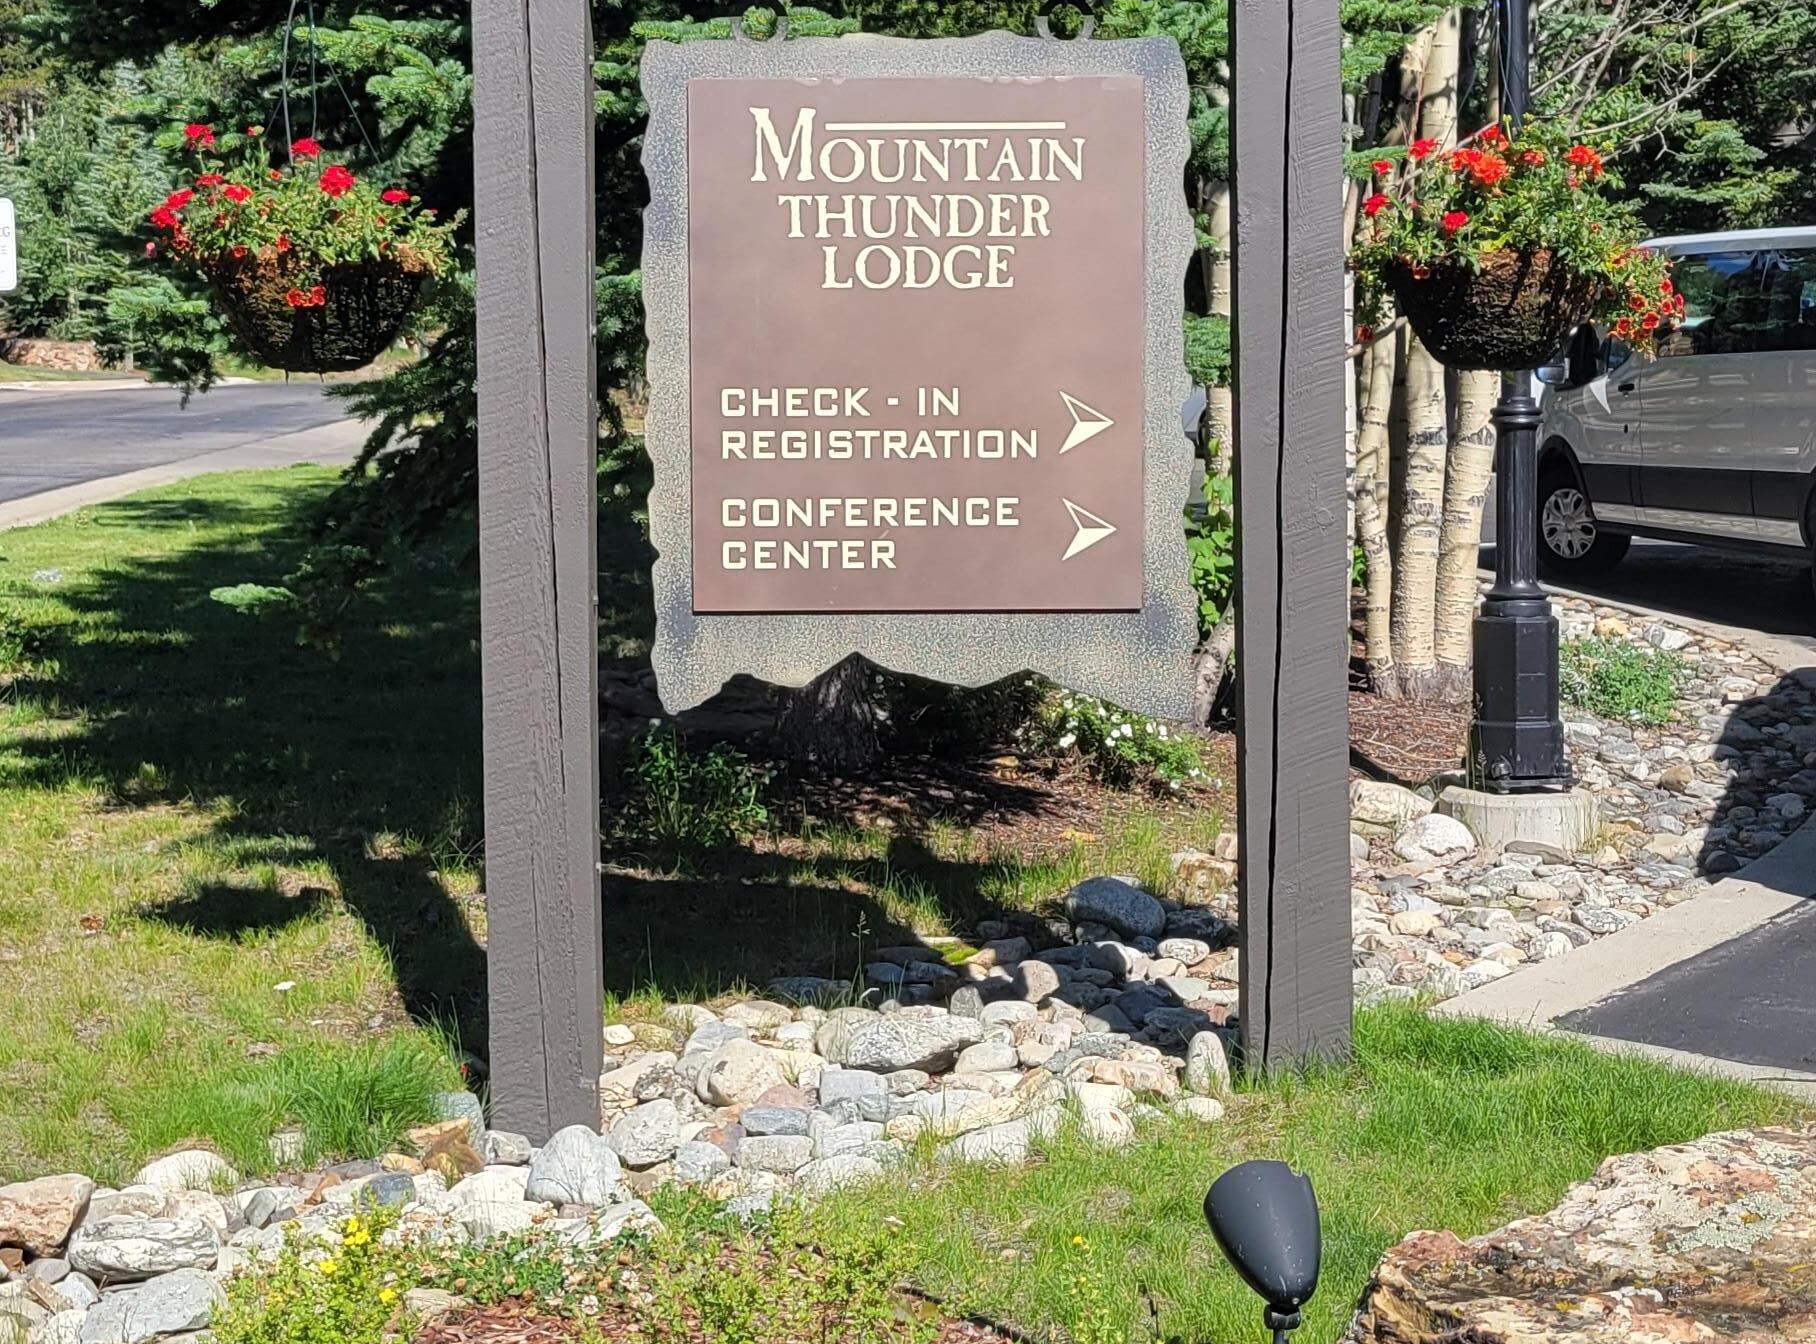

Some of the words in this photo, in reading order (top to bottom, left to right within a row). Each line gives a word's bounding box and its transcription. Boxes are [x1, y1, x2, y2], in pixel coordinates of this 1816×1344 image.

[749, 107, 1086, 183] MOUNTAIN
[778, 194, 1051, 239] THUNDER
[822, 245, 1015, 289] LODGE
[721, 387, 871, 417] CHECK
[918, 387, 960, 417] IN
[722, 429, 1038, 460] REGISTRATION
[722, 497, 1020, 527] CONFERENCE
[722, 540, 898, 570] CENTER
